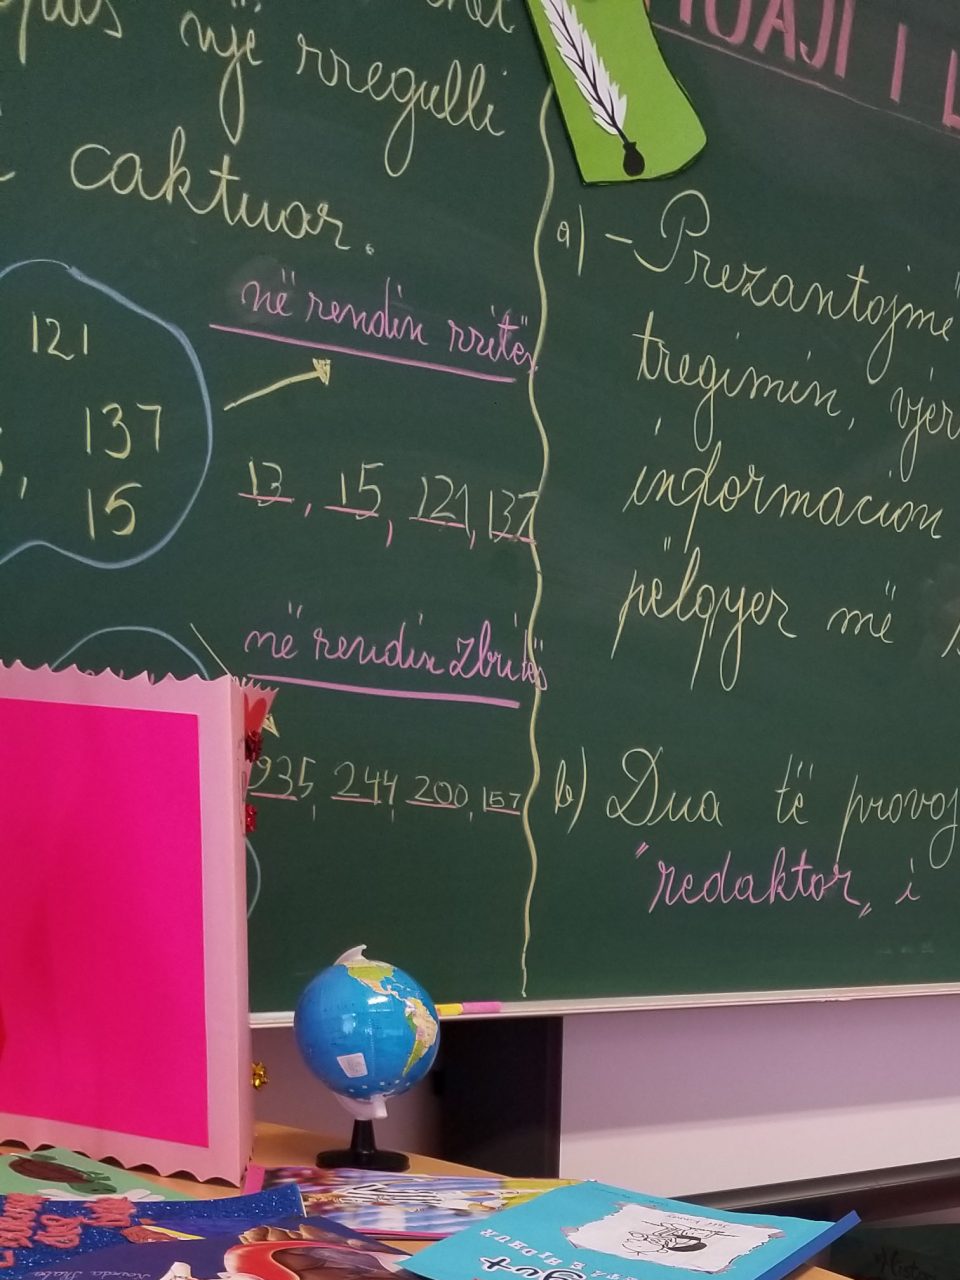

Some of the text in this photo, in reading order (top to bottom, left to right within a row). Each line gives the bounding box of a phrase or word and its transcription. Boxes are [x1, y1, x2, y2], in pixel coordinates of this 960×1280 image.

[679, 0, 854, 79] UAJI
[297, 33, 507, 178] rregulli
[31, 311, 89, 361] 121
[86, 403, 162, 460] 137
[87, 483, 142, 540] 15
[623, 417, 942, 553] informacion
[606, 746, 723, 826] Dua
